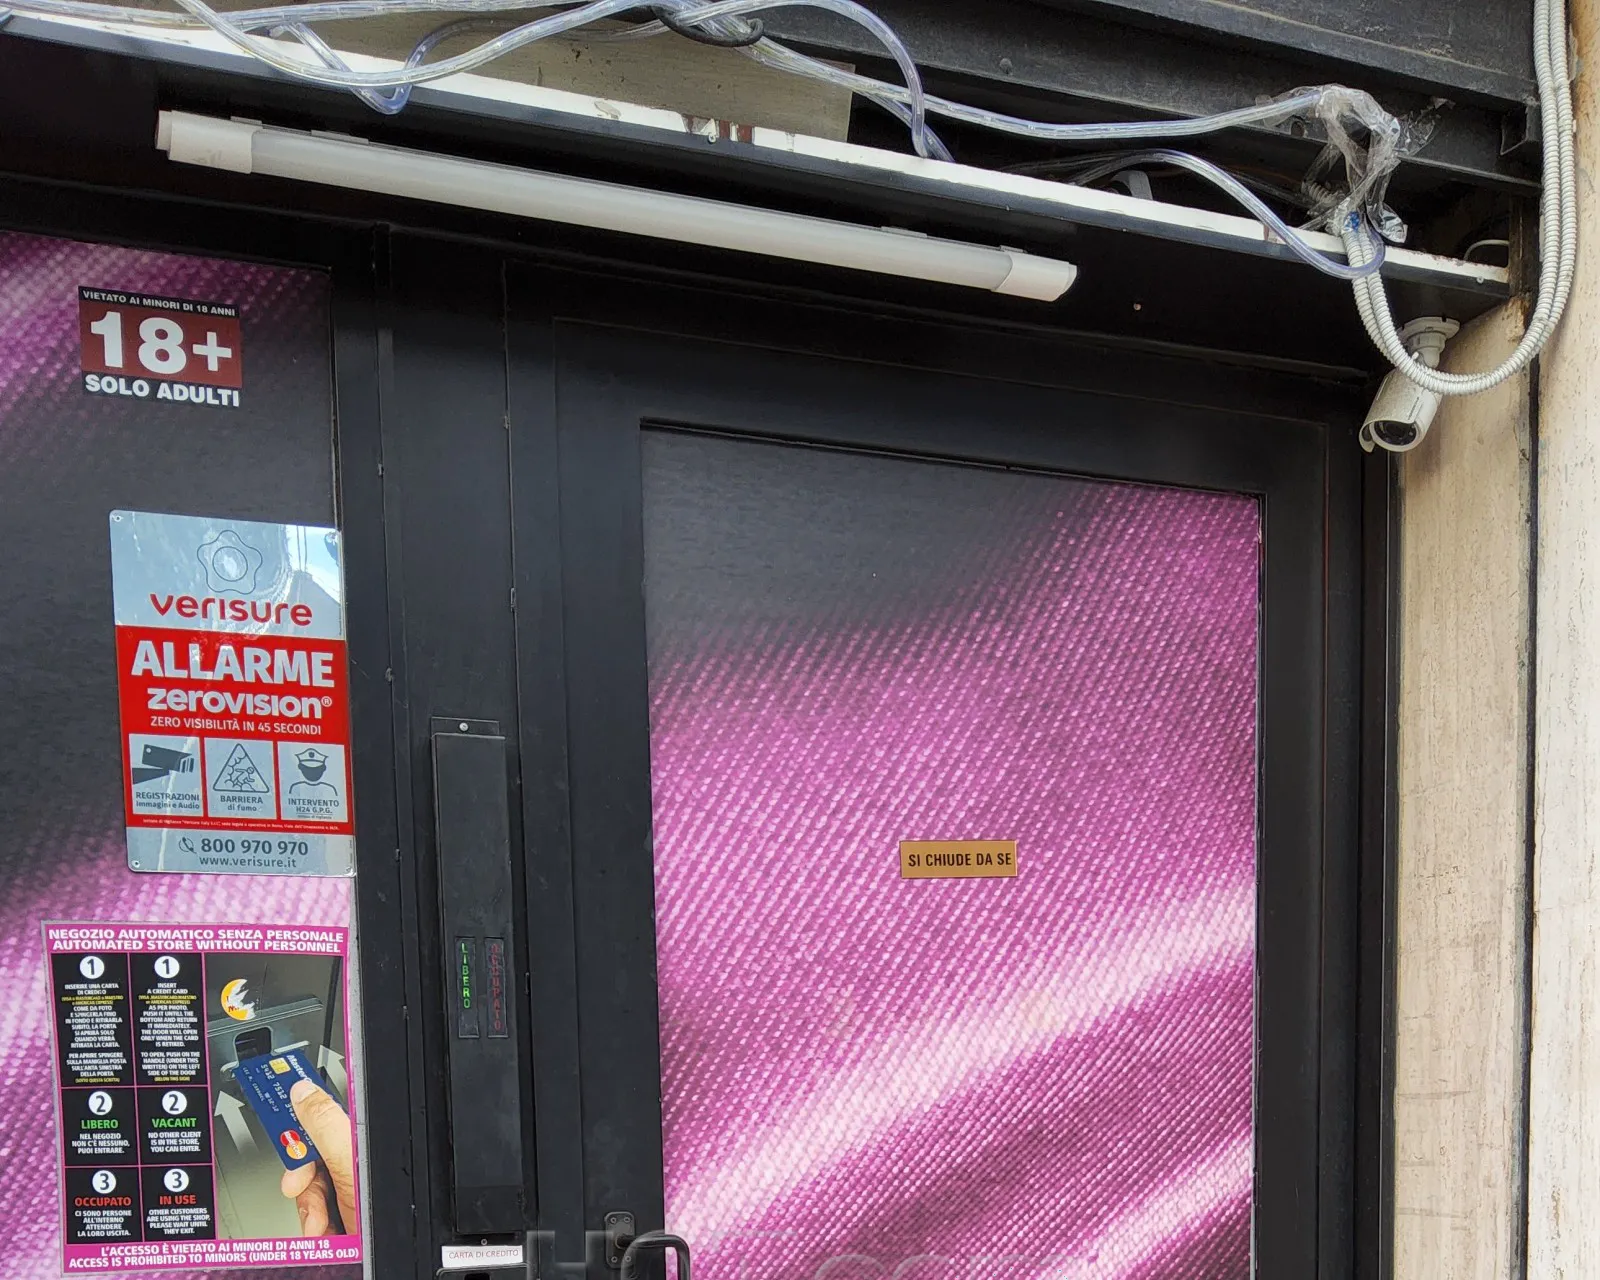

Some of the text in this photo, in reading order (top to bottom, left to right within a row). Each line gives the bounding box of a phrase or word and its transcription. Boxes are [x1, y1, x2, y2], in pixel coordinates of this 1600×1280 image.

[83, 290, 126, 303] VIETATO
[143, 299, 179, 309] MINORI
[183, 303, 193, 311] DI
[197, 305, 207, 313] 18
[211, 307, 235, 316] ANNI
[91, 311, 232, 374] 18+
[85, 374, 239, 407] SOLO ADULTI
[150, 594, 313, 626] verisure
[131, 640, 335, 687] ALLARME
[151, 716, 321, 735] ZERO VISIBILITÀ IN 45 SECONDI
[136, 792, 199, 801] REGISTRAZIONI
[220, 795, 263, 804] BARRIERA
[288, 798, 339, 807] INTERVENTO
[136, 801, 171, 809] Immagini
[313, 806, 333, 814] G.P.G.
[201, 839, 308, 855] 800 970 970
[199, 856, 296, 868] www.verisure.it
[908, 853, 1011, 867] SI CHIUDE DA SE
[49, 929, 343, 942] NEGOZIO AUTOMATICO SENZA PERSONALE
[53, 940, 340, 952] AUTOMATED STORE WITHOUT PERSONNEL
[461, 943, 470, 1008] LIBERO
[286, 1055, 312, 1081] Master
[81, 1120, 118, 1129] LIBERO
[152, 1118, 197, 1128] VACANT
[75, 1197, 131, 1207] OCCUPATO
[160, 1195, 196, 1205] IN USE
[101, 1240, 330, 1257] L'ACCESSO È VIETATO AI MINORI DI ANNI 18
[69, 1248, 359, 1268] ACCESS IS PROHIBITED TO MINORS (UNDER 18 YEARS OLD)
